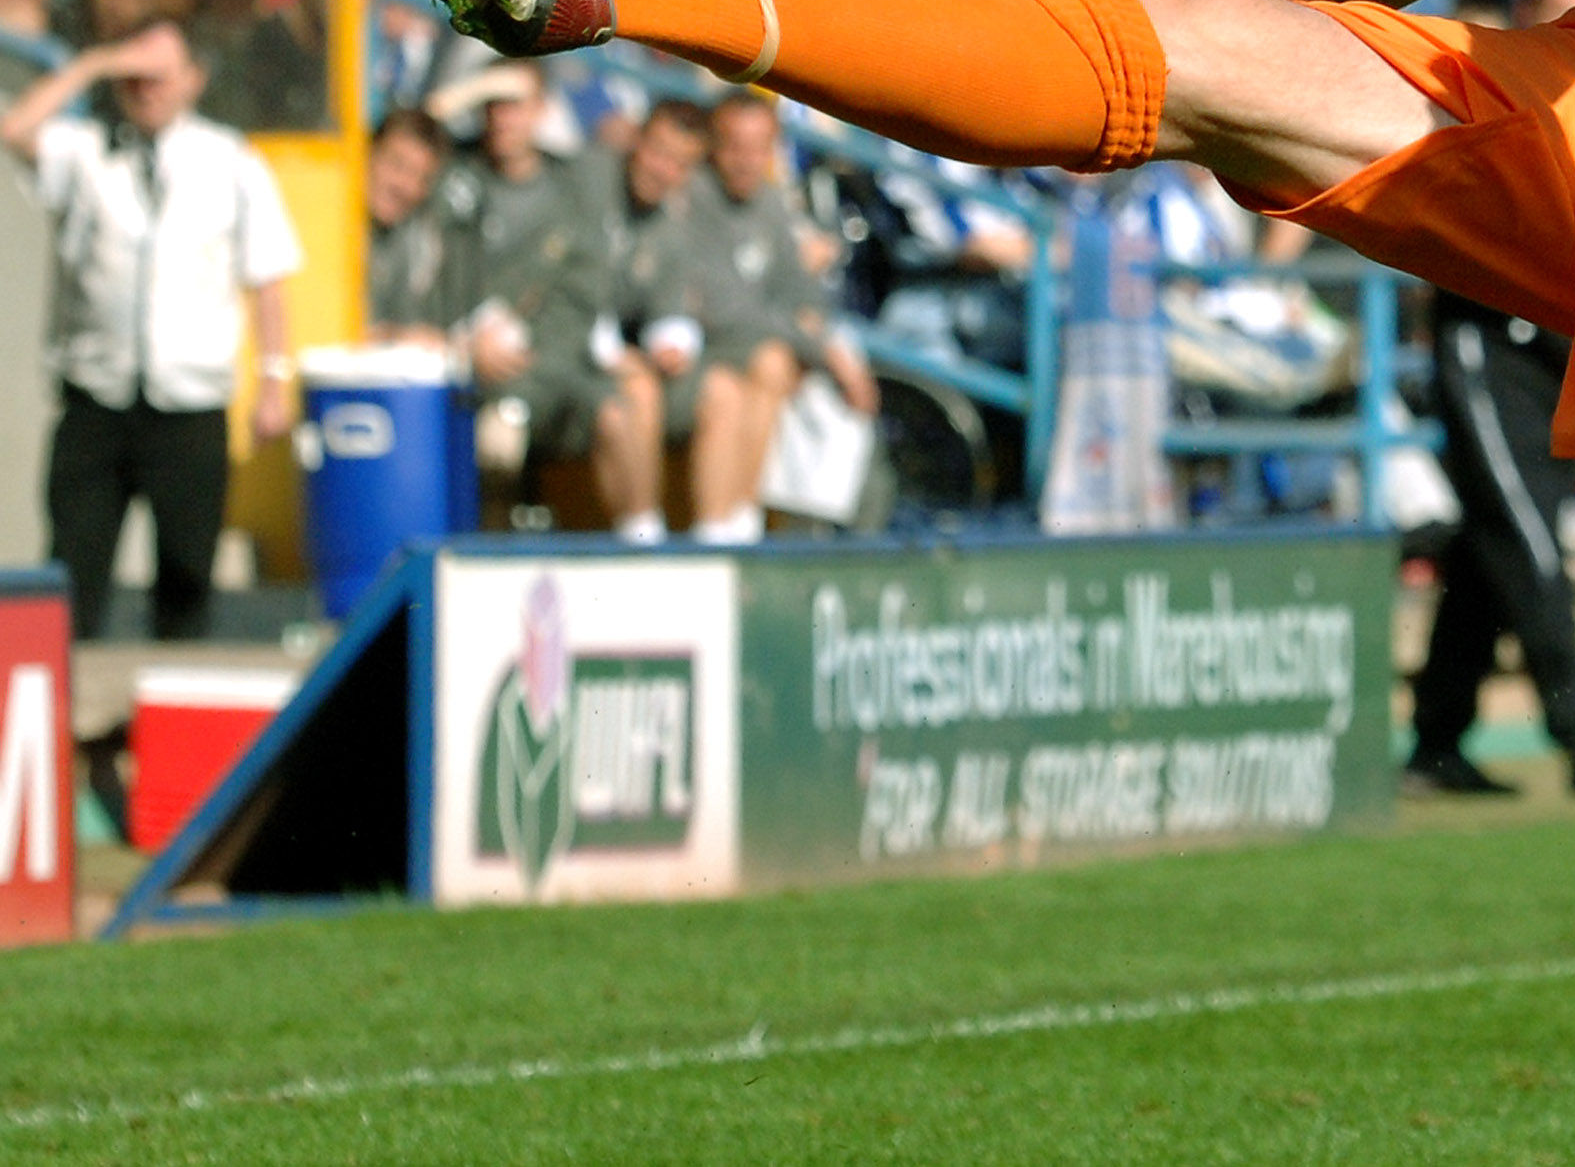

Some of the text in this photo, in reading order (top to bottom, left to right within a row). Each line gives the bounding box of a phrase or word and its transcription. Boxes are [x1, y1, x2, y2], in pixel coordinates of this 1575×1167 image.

[812, 571, 1354, 735] Professionals in Warehousing
